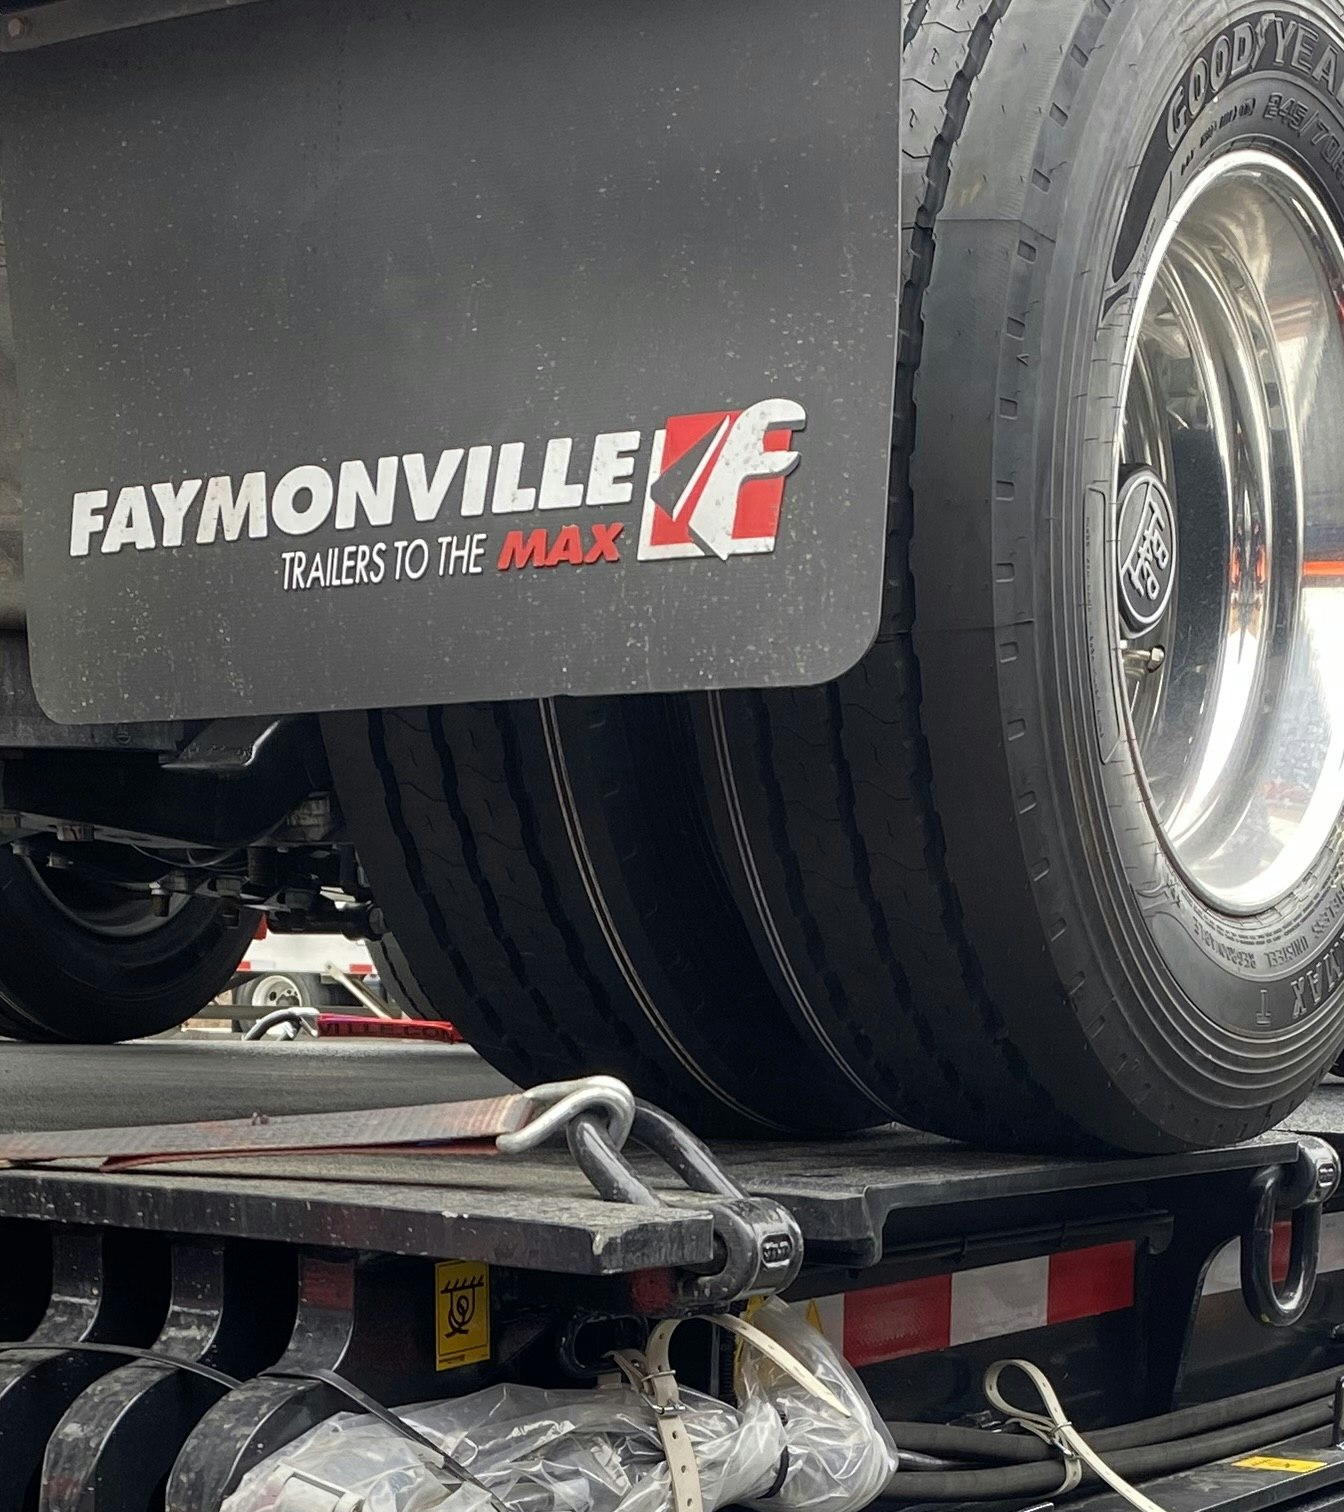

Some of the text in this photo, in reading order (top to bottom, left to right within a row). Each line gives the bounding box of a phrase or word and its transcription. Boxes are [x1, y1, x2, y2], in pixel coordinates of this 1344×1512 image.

[68, 428, 642, 558] FAYMONVILLE
[281, 522, 623, 592] TRAILERS TO THE MAX
[1255, 988, 1272, 1027] T
